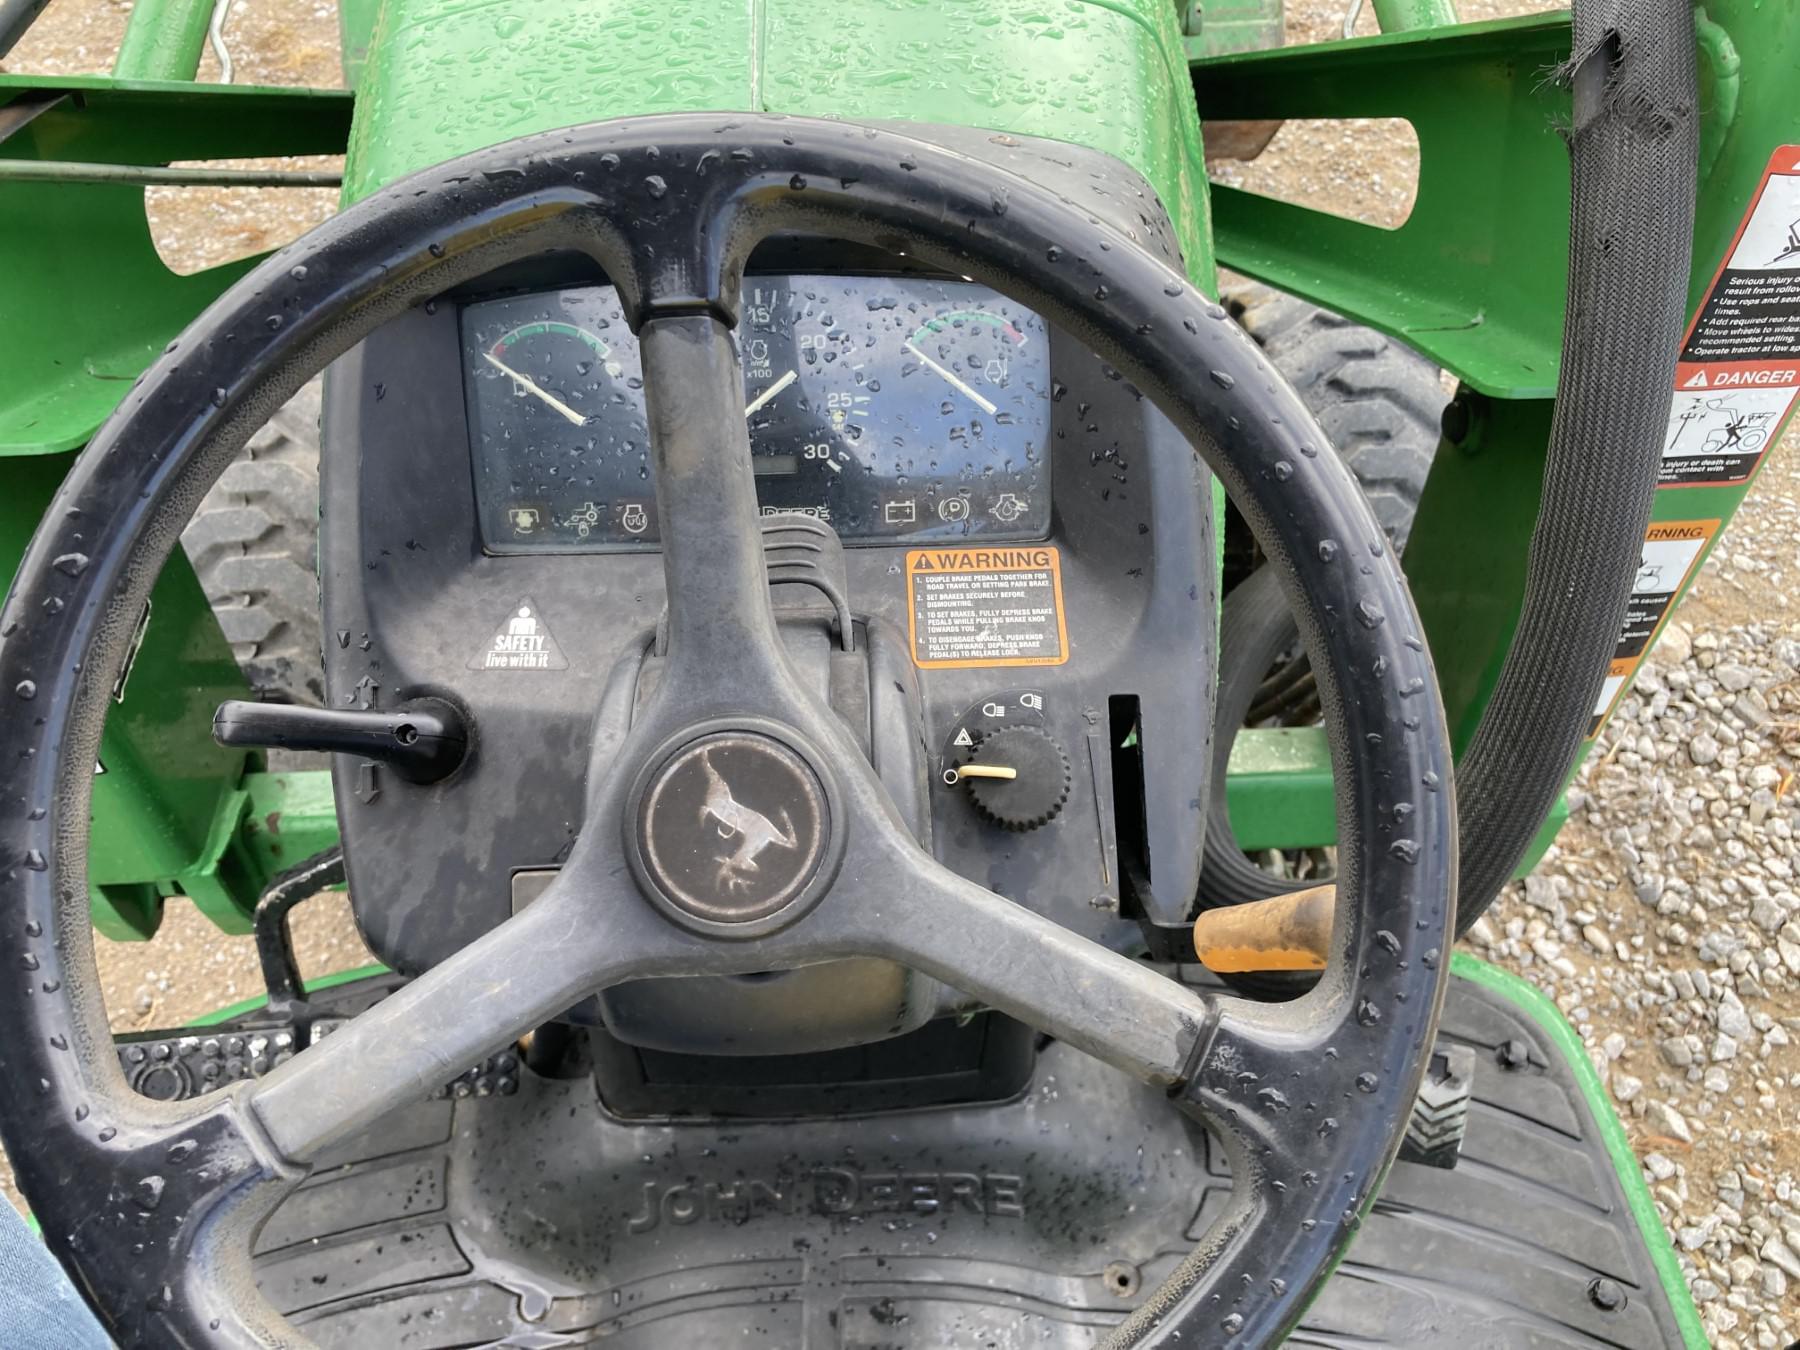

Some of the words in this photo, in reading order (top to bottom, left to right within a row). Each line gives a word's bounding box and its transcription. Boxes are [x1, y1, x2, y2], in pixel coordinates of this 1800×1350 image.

[1729, 277, 1765, 285] Serious
[1766, 276, 1793, 286] injury
[1761, 296, 1780, 304] and
[750, 307, 770, 323] 15
[1729, 317, 1768, 326] required
[1730, 327, 1760, 335] wheels
[801, 335, 826, 349] 20
[1699, 336, 1762, 345] recommended
[1763, 335, 1795, 343] setting.
[1694, 348, 1730, 356] Operate
[1731, 346, 1760, 354] tractor
[747, 369, 772, 378] x100
[1713, 370, 1796, 385] DANGER
[827, 392, 852, 407] 25
[804, 445, 829, 459] 30
[1648, 527, 1703, 539] RNING
[937, 551, 1050, 569] WARNING
[927, 600, 973, 608] DISMOUNTING.
[927, 611, 936, 619] TO
[979, 609, 1000, 617] FULLY
[1001, 608, 1031, 616] DEPRESS
[1032, 607, 1053, 615] BRAKE
[928, 625, 959, 633] TOWARDS
[494, 635, 544, 651] SAFETY
[928, 636, 937, 644] TO
[987, 642, 1018, 650] DEPRESS
[1018, 641, 1040, 649] BRAKE
[929, 651, 960, 659] PEDAL(S)
[971, 649, 1001, 657] RELEASE
[485, 653, 507, 667] live
[509, 653, 536, 667] with
[538, 653, 548, 667] it
[627, 1180, 797, 1235] JOHN
[811, 1166, 1024, 1218] DEERE
